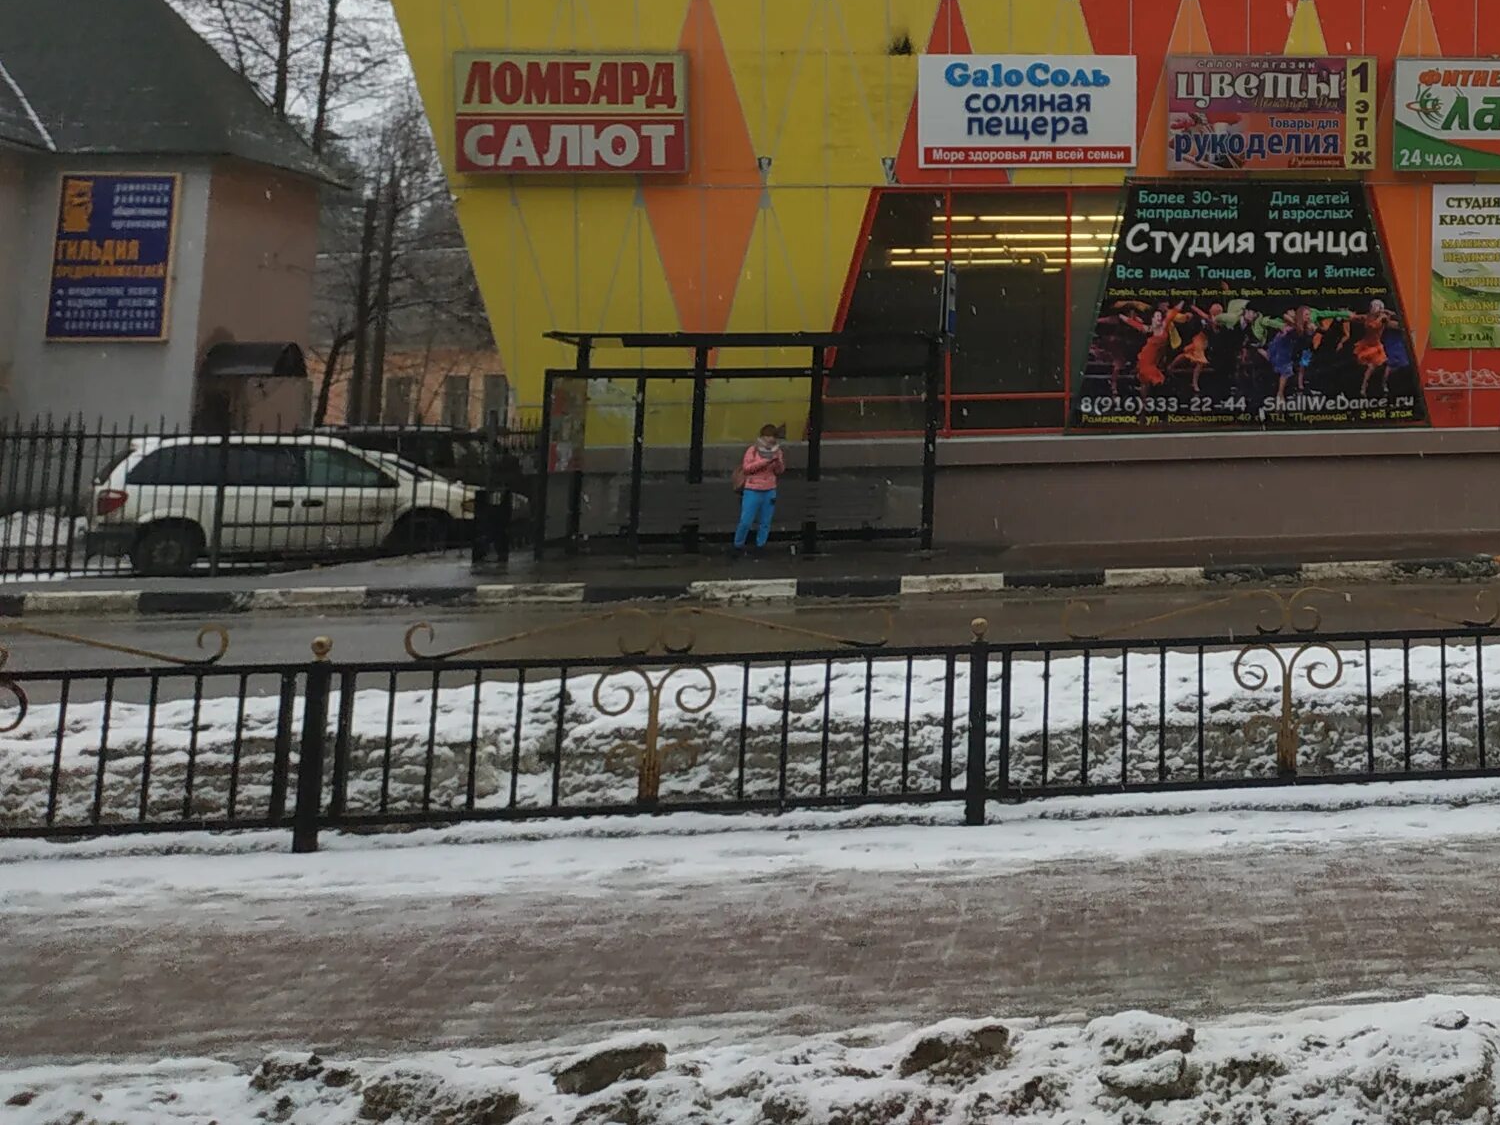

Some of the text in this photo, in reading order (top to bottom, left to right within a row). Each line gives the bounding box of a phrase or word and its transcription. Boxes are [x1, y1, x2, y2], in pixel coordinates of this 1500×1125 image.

[462, 61, 677, 109] ЛОМБАРД
[1352, 61, 1370, 93] 1
[965, 93, 1091, 113] соляная
[967, 116, 1089, 142] пещера
[1269, 117, 1339, 130] Товары для
[1351, 99, 1372, 165] этаж
[463, 124, 675, 167] САЛЮТ
[1175, 133, 1339, 161] рукоделия
[932, 148, 1124, 162] Море здоровья для всей семьи
[1400, 149, 1463, 166] 24 ЧАСА
[1139, 191, 1238, 205] Более 30-ти
[1271, 191, 1350, 206] Для детей
[1445, 197, 1500, 209] СТУДИЯ
[1137, 207, 1238, 220] направлений
[1269, 209, 1353, 223] и взрослых
[1126, 223, 1368, 262] Студия танца
[1116, 262, 1375, 281] Все виды Танцев, Йога и Фитнес
[1459, 333, 1494, 343] ЭТАЖ
[1080, 396, 1247, 415] 8(916)333-22-44
[1263, 394, 1414, 411] ShallWeDance.ru
[1081, 414, 1140, 424] Раменское,
[1145, 416, 1162, 425] ул.
[1390, 410, 1413, 418] этаж
